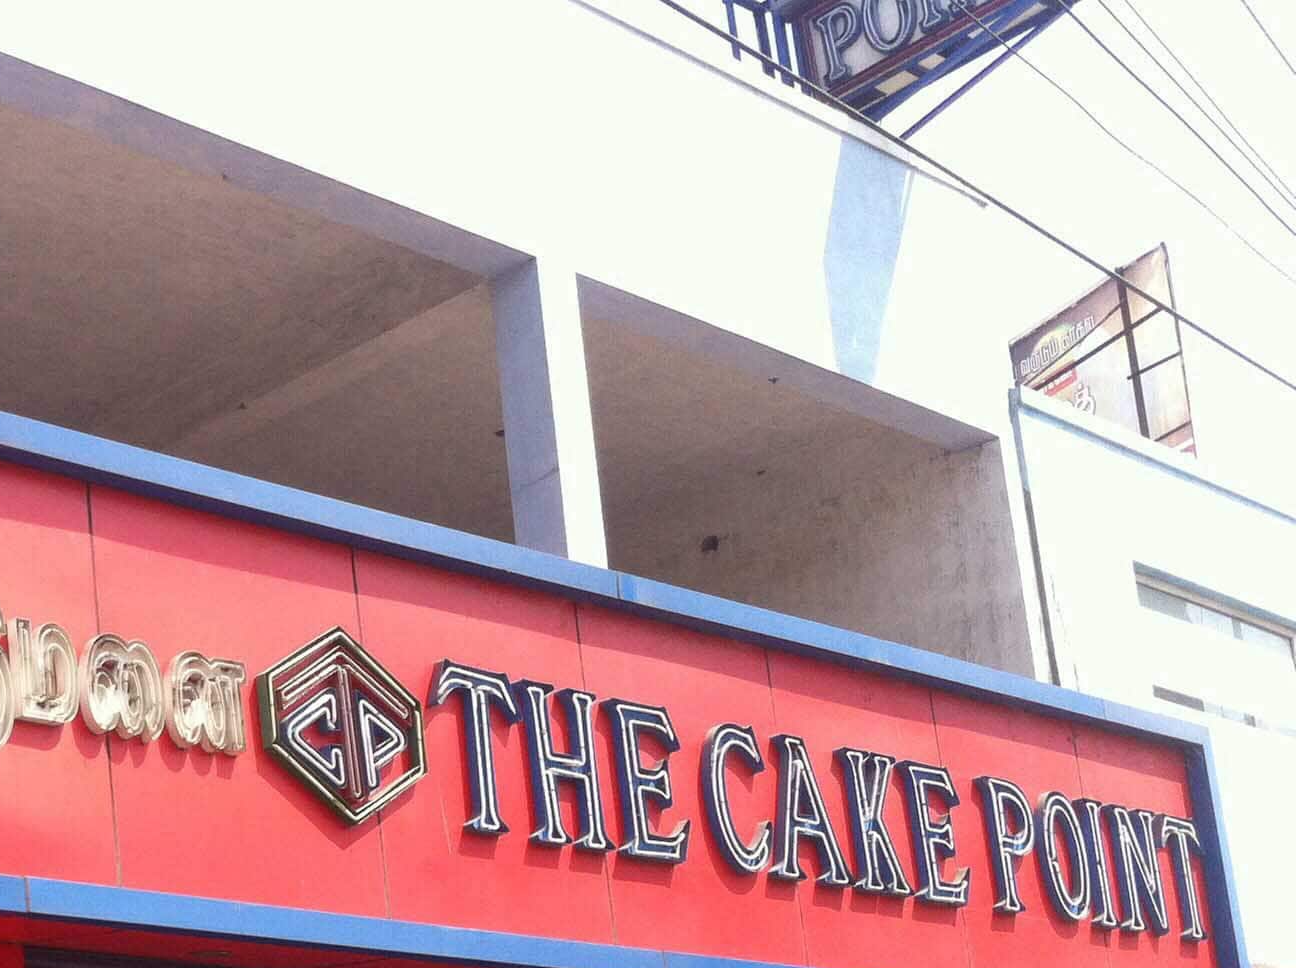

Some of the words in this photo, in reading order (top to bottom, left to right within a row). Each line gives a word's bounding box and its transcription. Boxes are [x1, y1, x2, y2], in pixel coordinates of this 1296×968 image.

[814, 0, 966, 84] PO
[429, 658, 690, 865] THE
[705, 723, 971, 907] CAKE
[974, 775, 1209, 943] POINT
